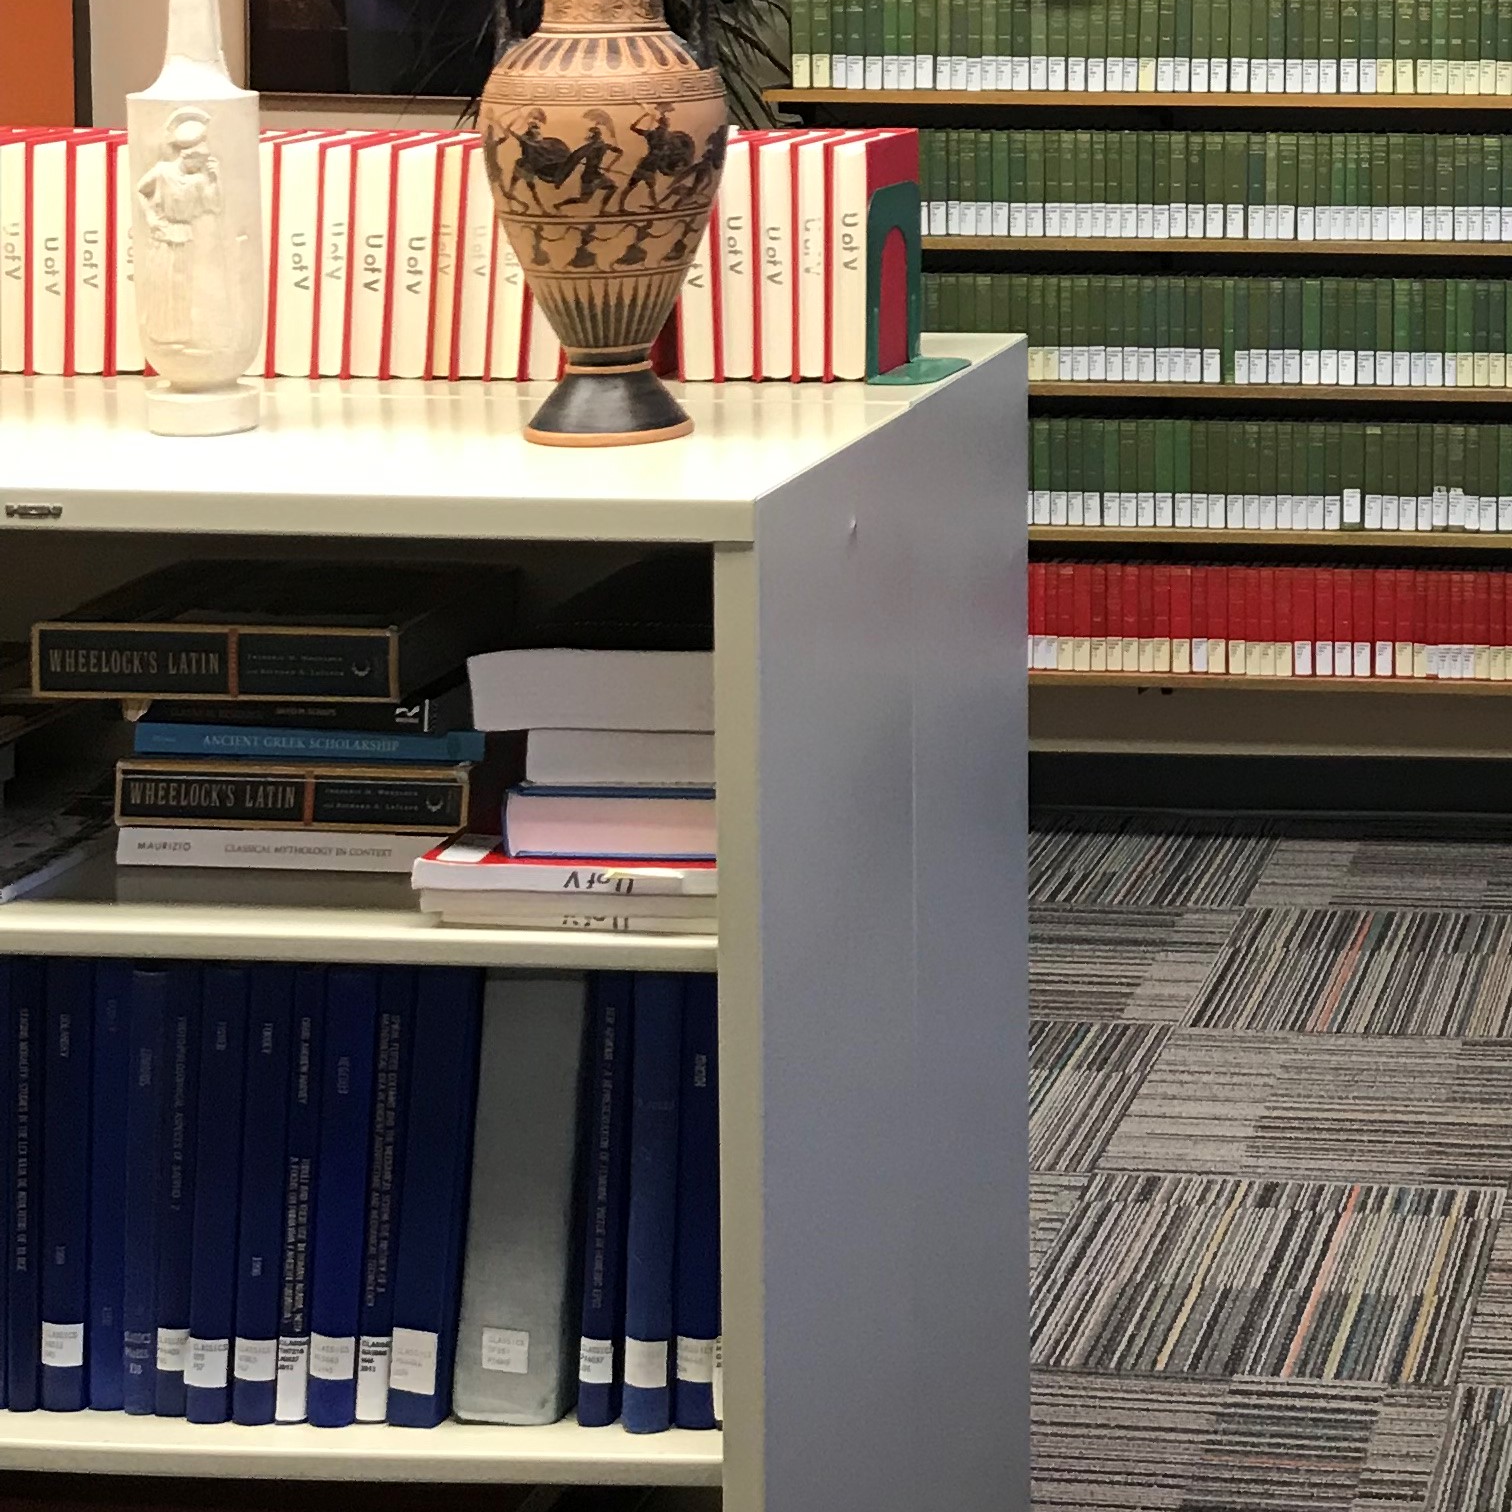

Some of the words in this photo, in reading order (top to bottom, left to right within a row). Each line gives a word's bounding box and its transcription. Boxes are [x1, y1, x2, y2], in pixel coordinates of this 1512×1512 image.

[727, 216, 743, 230] U
[842, 213, 858, 227] U
[84, 230, 98, 244] U
[292, 232, 306, 247] U
[766, 226, 780, 240] U
[45, 238, 59, 251] U
[365, 234, 384, 248] U
[408, 237, 426, 251] U
[727, 236, 743, 255] of
[842, 234, 860, 251] of
[83, 250, 99, 269] of
[292, 252, 308, 271] of
[364, 254, 382, 273] of
[766, 247, 782, 266] of
[842, 257, 858, 270] V
[406, 256, 424, 276] of
[473, 265, 486, 277] V
[729, 260, 743, 275] V
[83, 274, 99, 289] V
[294, 276, 310, 291] V
[504, 273, 518, 285] V
[688, 274, 704, 288] V
[766, 271, 783, 285] V
[45, 282, 61, 296] V
[363, 279, 379, 292] V
[406, 281, 422, 295] V
[49, 648, 158, 675] WHEELOCK'S
[168, 652, 219, 675] LATIN
[203, 735, 258, 746] ANCIENT
[264, 737, 306, 748] GREEK
[309, 739, 399, 752] SCHOLARSHIP
[130, 782, 235, 806] WHEELOCK'S
[245, 786, 296, 808] LATIN
[137, 842, 191, 852] MAURIZIO
[224, 845, 272, 854] CLASSICAL
[274, 846, 333, 856] MYTHOLOGY
[336, 847, 346, 856] IN
[349, 848, 392, 857] CONTEXT
[562, 871, 579, 888] V
